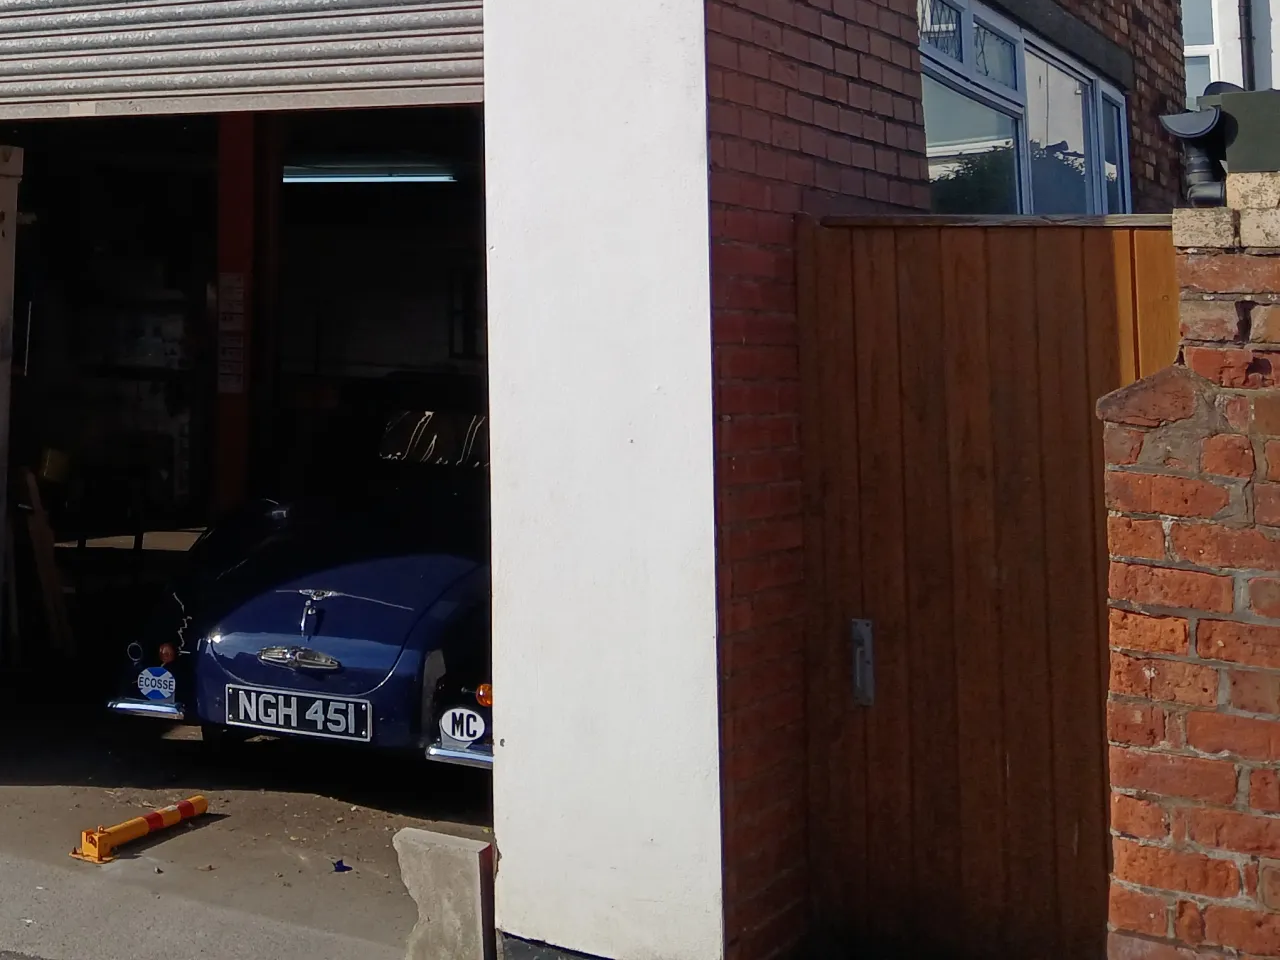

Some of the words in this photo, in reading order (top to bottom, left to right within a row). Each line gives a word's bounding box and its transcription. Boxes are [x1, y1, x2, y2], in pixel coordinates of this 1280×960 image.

[138, 676, 174, 691] ECOSSE
[238, 690, 297, 727] NGH
[305, 699, 355, 734] 451
[451, 711, 477, 738] MC
